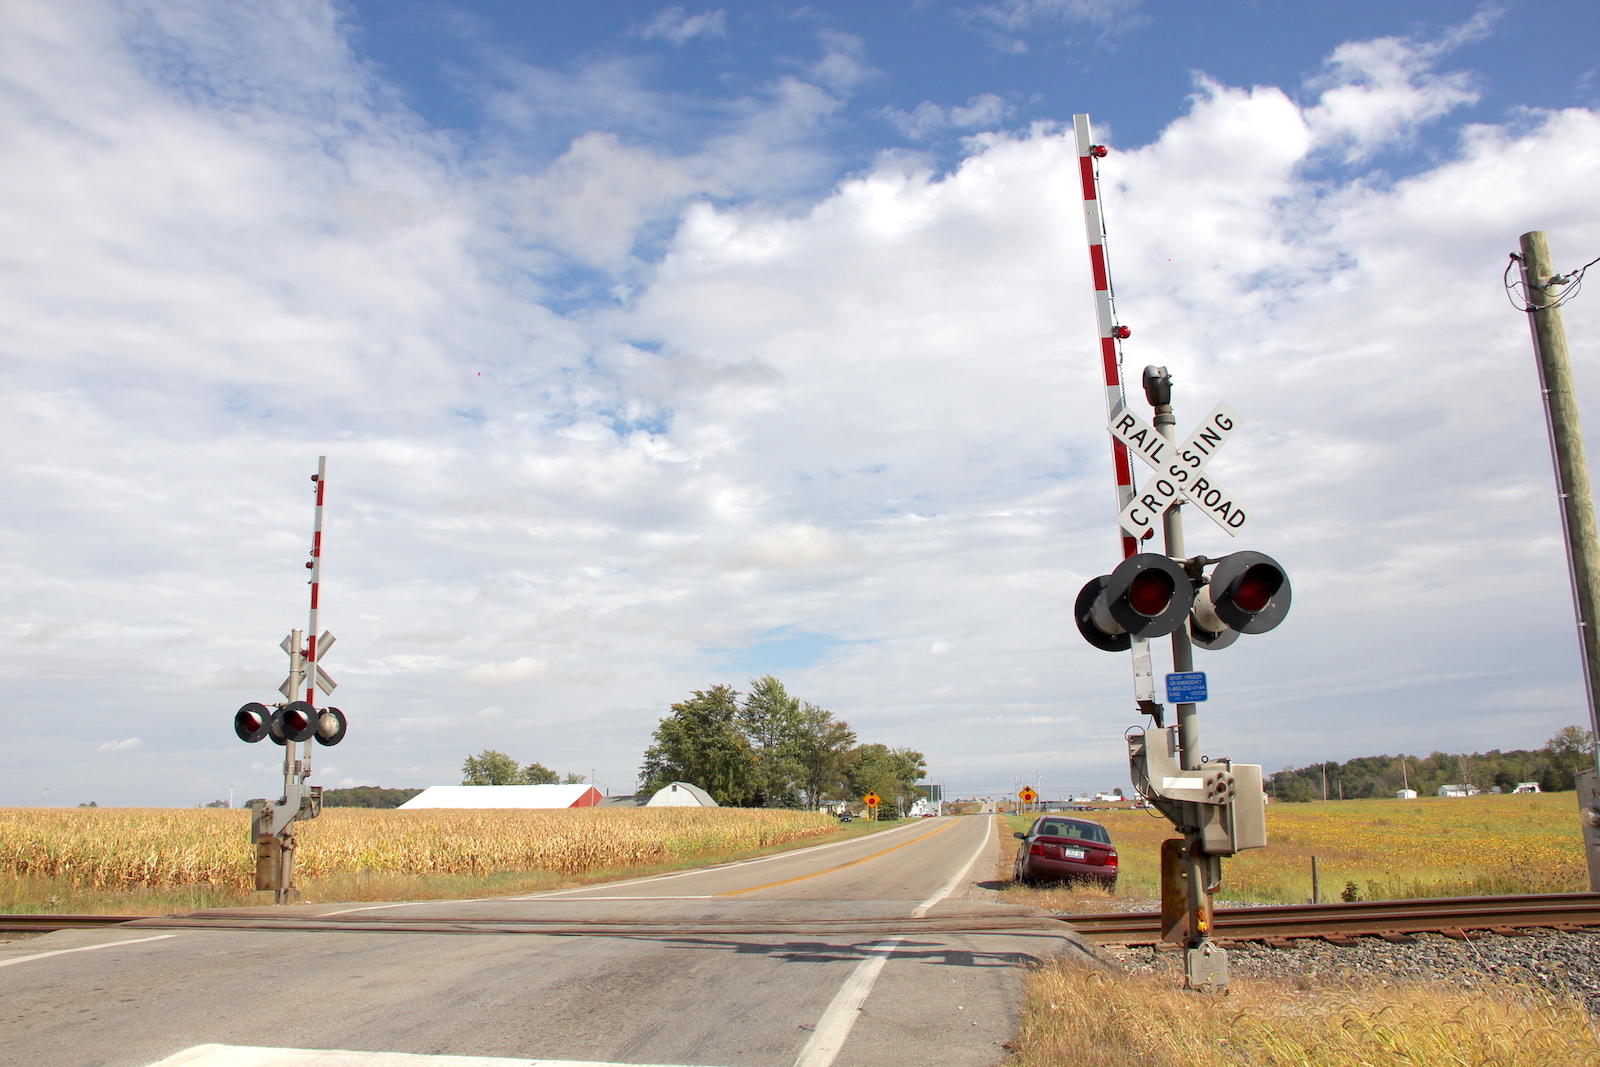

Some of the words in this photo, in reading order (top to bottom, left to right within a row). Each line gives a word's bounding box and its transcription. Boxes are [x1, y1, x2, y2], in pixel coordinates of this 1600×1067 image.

[1115, 414, 1164, 464] RAIL
[1189, 477, 1246, 528] ROAD
[1129, 413, 1233, 526] CROSSING
